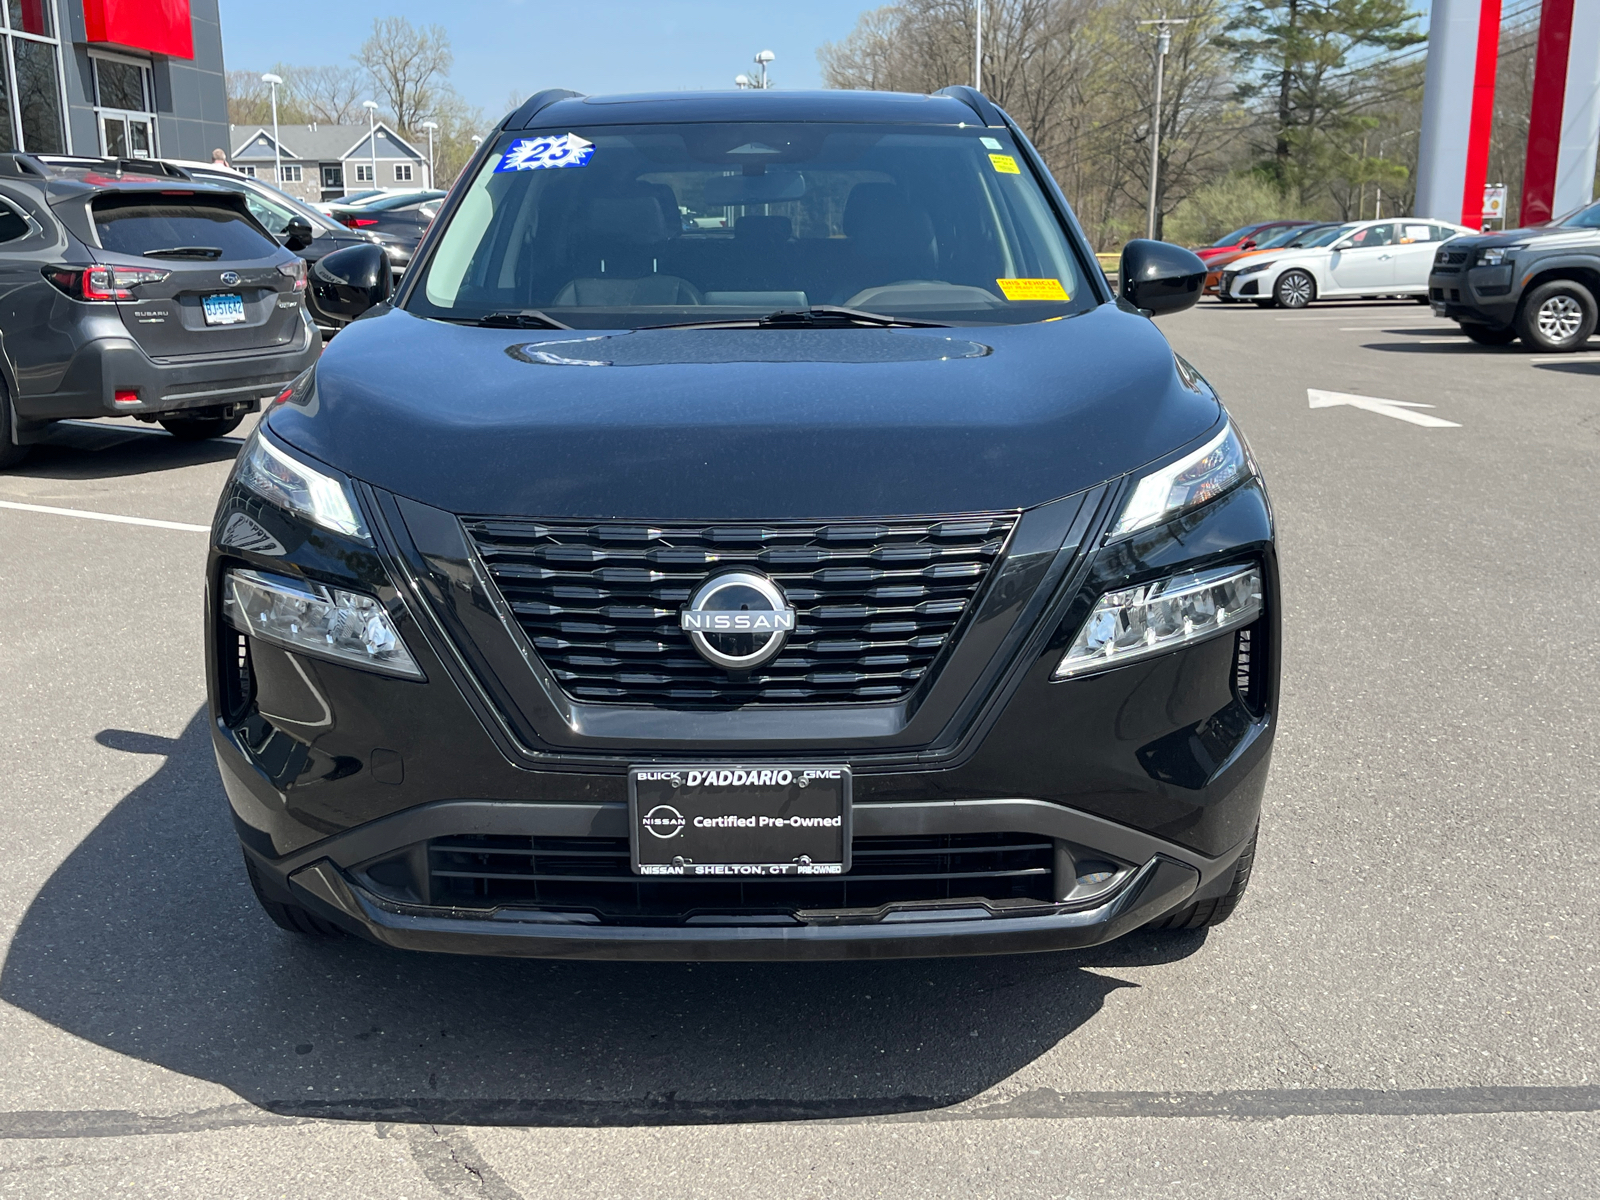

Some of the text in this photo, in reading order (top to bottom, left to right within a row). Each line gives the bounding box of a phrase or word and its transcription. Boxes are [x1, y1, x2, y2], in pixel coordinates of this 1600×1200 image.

[684, 613, 791, 629] NISSAN
[637, 772, 681, 781] BUICK
[686, 770, 793, 787] D'ADDARIO
[803, 770, 841, 779] GMC
[642, 817, 686, 826] NISSAN
[693, 816, 842, 828] Certified Pre-Owned
[640, 866, 684, 875] NISSAN
[695, 866, 789, 875] SHELTON, CT
[797, 865, 842, 874] PRE-OWNED
